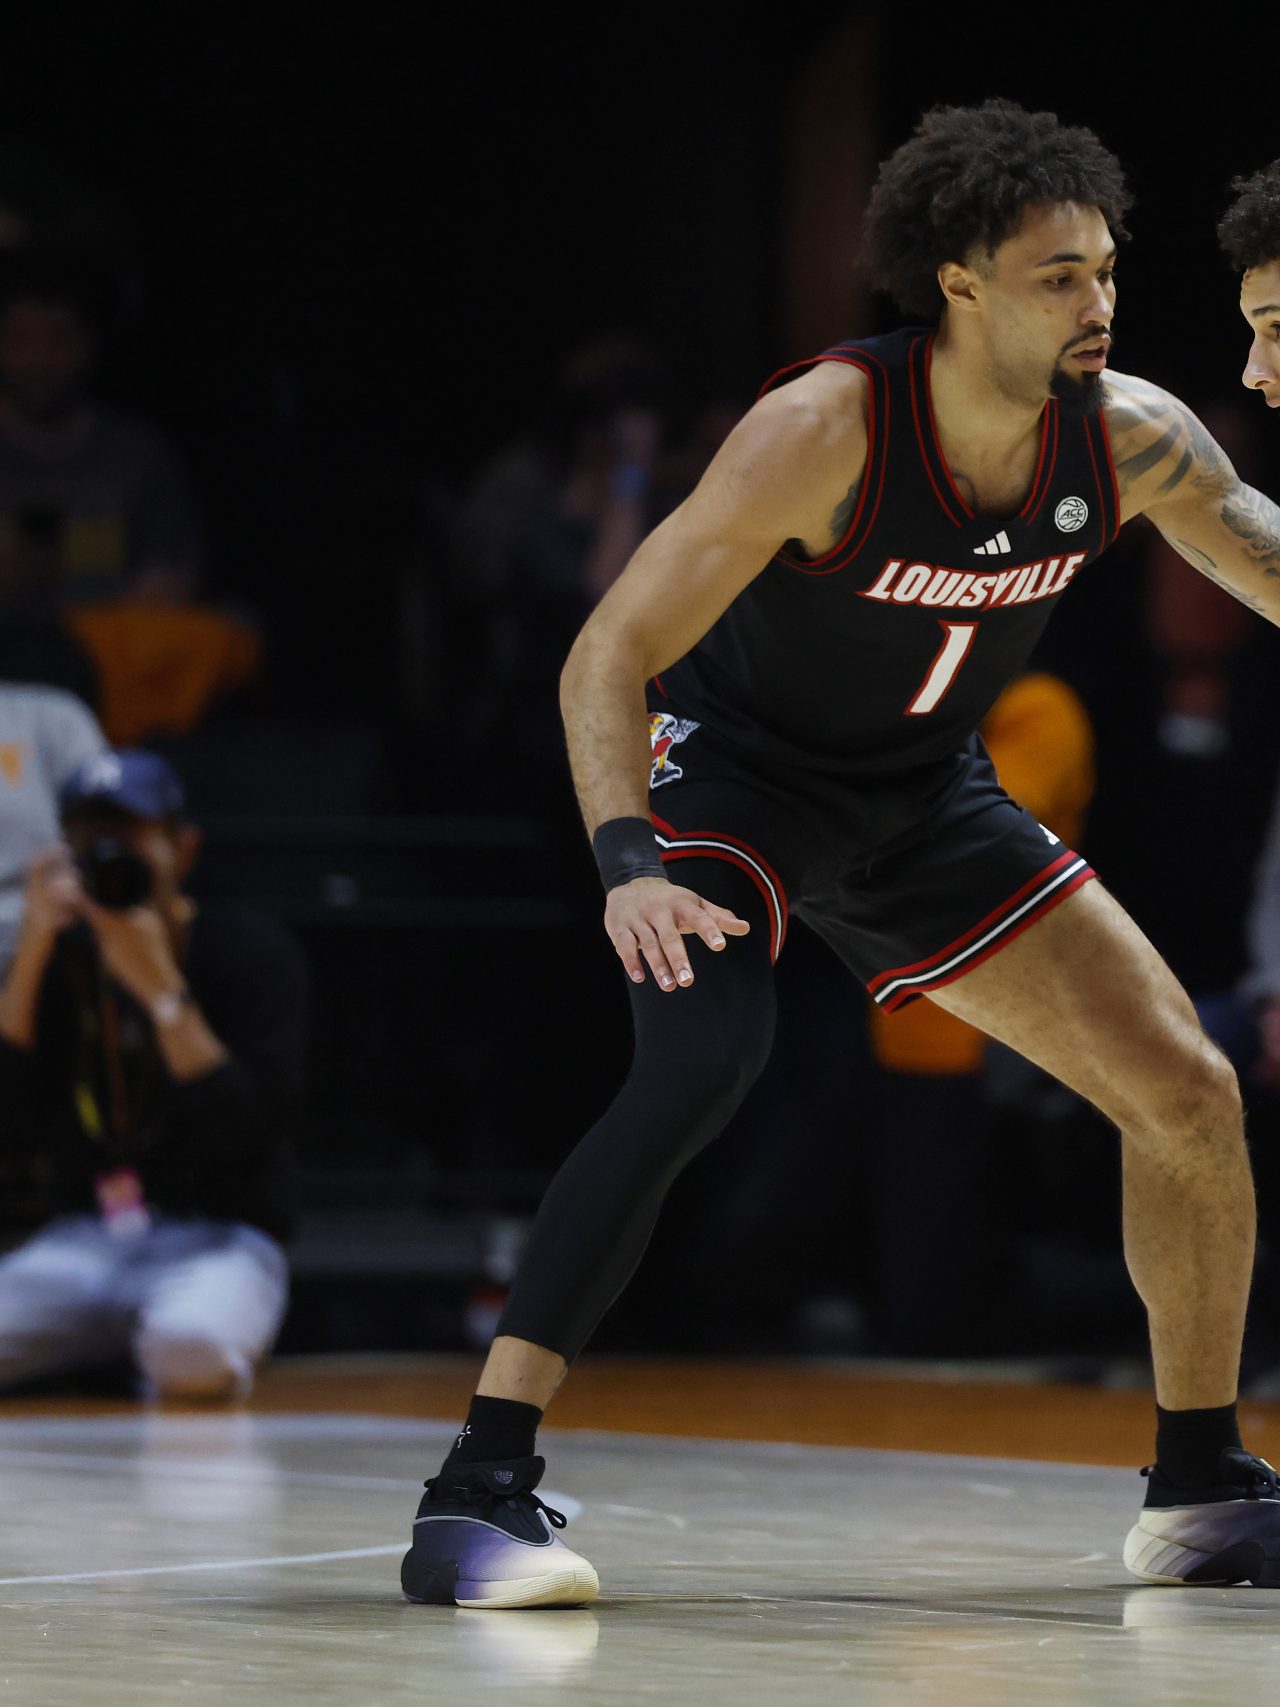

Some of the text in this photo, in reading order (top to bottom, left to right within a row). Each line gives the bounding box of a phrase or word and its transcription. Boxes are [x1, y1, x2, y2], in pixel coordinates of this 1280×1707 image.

[1061, 508, 1085, 519] ACC
[860, 552, 1087, 609] LOUISVILLE
[906, 621, 978, 715] 1
